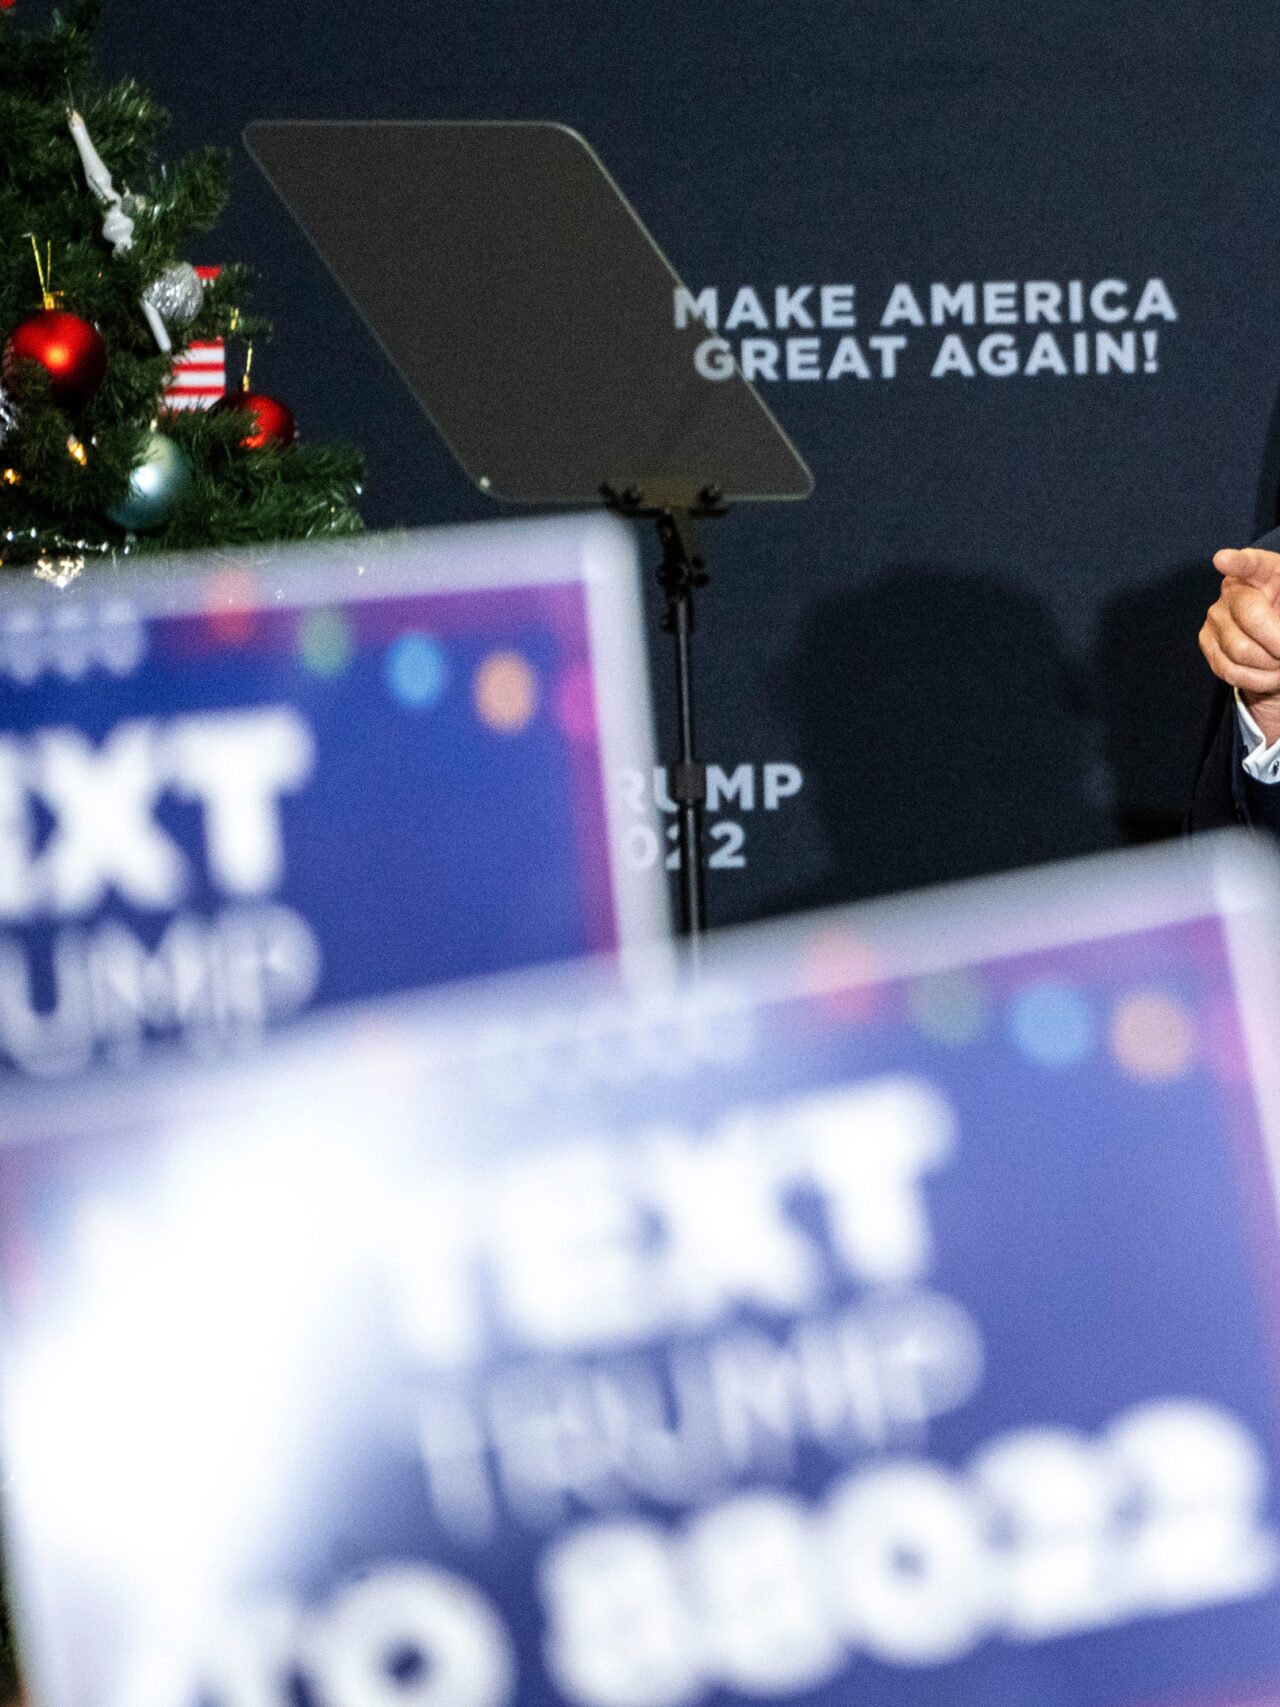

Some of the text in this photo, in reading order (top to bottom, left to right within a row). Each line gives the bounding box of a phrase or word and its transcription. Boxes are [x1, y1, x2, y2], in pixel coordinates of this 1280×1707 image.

[673, 279, 1179, 330] MAKE AMERICA
[693, 329, 1159, 381] GREAT AGAIN!
